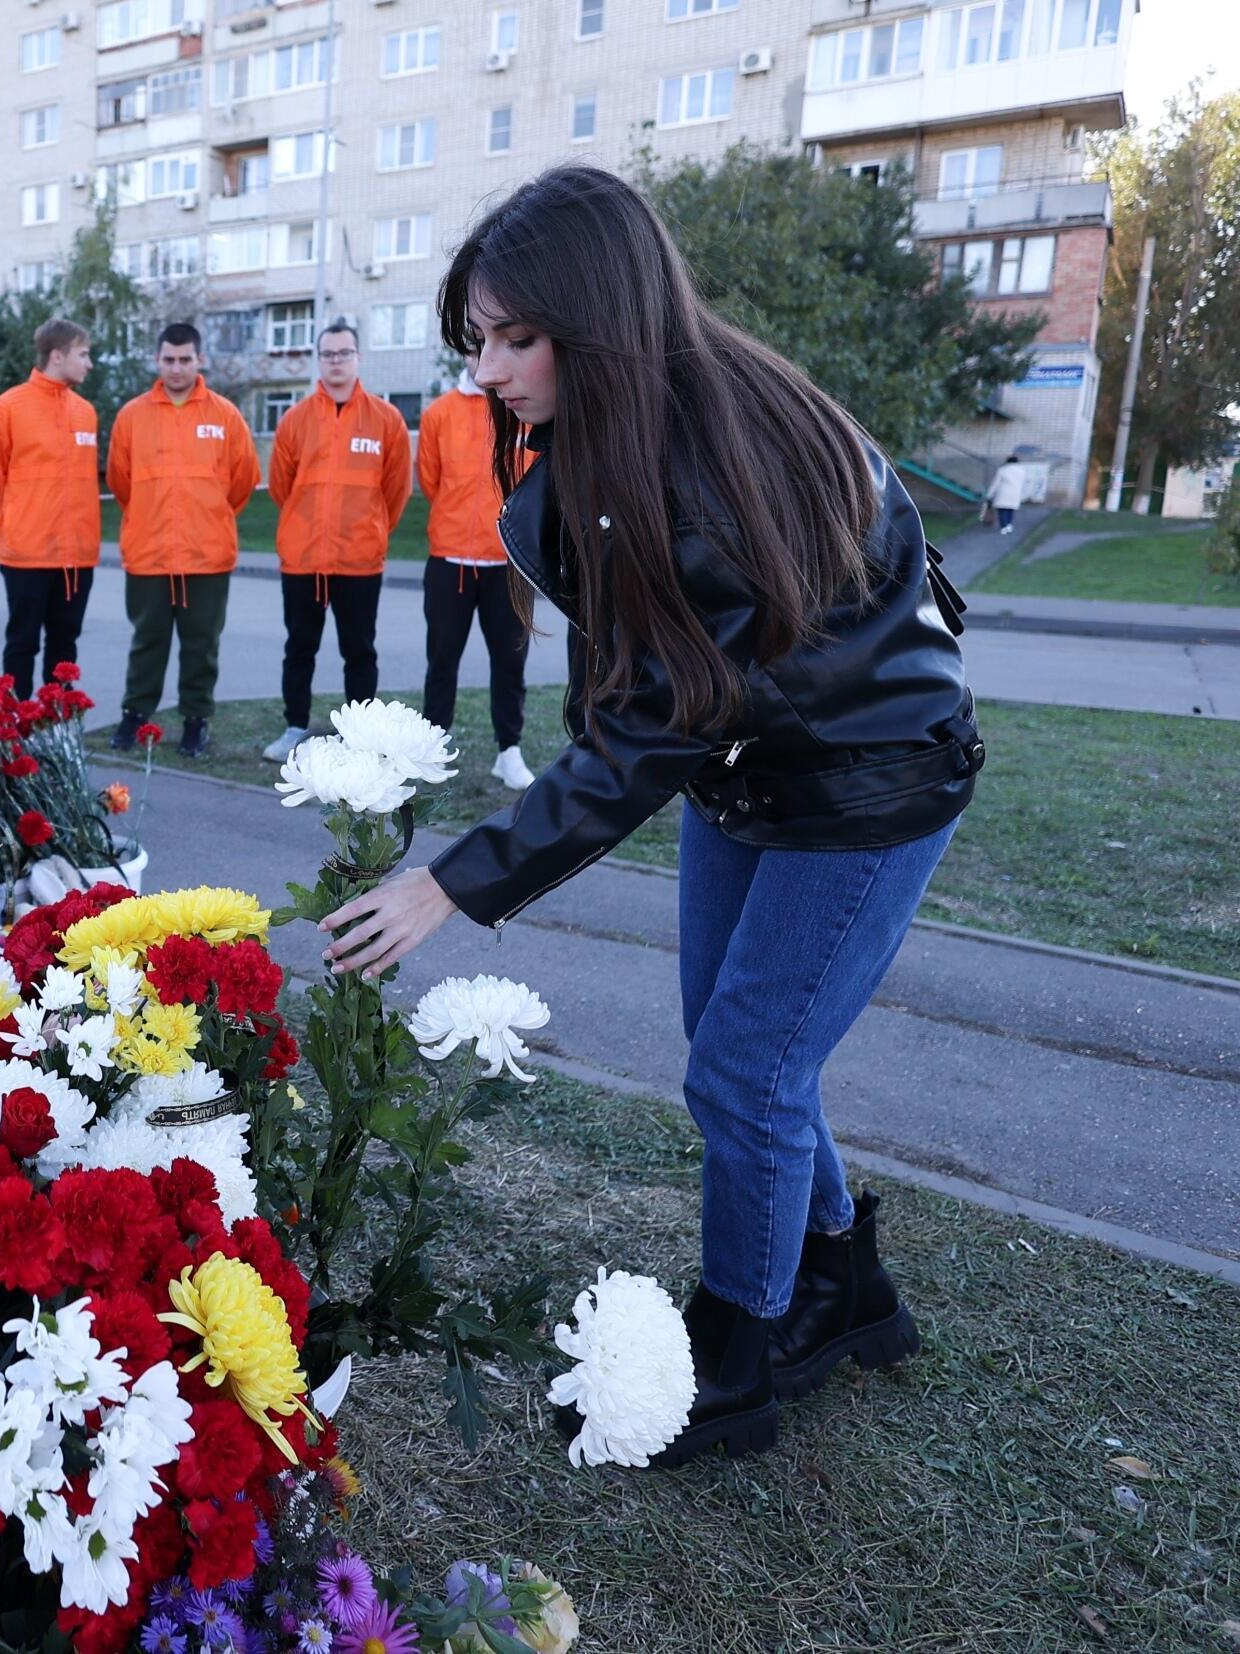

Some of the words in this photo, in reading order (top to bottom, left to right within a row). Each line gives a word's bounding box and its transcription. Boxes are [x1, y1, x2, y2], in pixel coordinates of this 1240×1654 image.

[196, 424, 225, 440] ЕПК
[350, 437, 382, 456] ЕПК
[181, 1106, 216, 1120] ПАМЯТЬ
